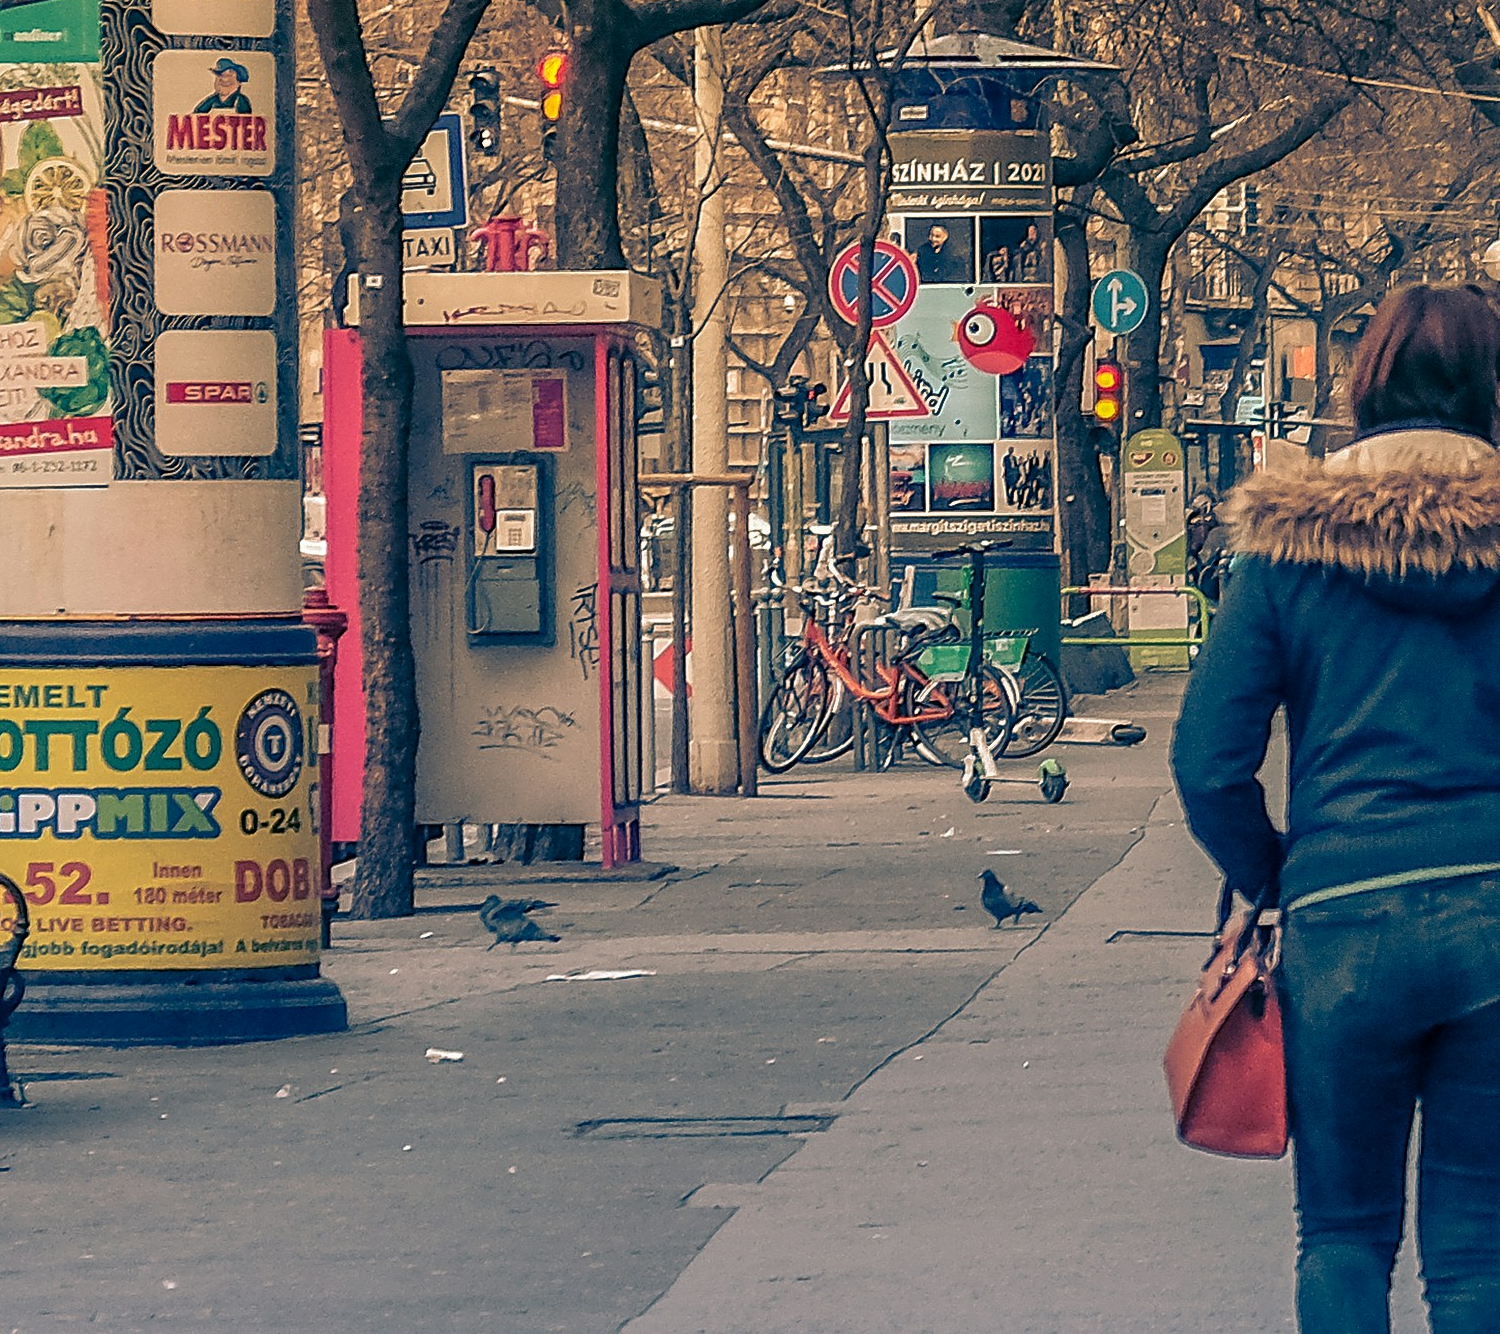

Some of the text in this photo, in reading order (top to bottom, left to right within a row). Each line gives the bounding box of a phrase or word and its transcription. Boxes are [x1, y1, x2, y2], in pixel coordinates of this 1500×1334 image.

[166, 114, 268, 152] MESTER
[891, 157, 1046, 183] SZÍNHÁZ 2021
[161, 232, 273, 254] ROSSMANN
[403, 236, 451, 258] TAXI
[184, 385, 251, 401] SPAR
[240, 807, 301, 835] 0-24
[152, 861, 203, 879] Innen
[24, 860, 111, 906] 52.
[171, 885, 223, 904] méter
[36, 917, 84, 933] LIVE
[91, 916, 195, 934] BETTING.
[20, 938, 224, 959] gjobb fogadóirodája!
